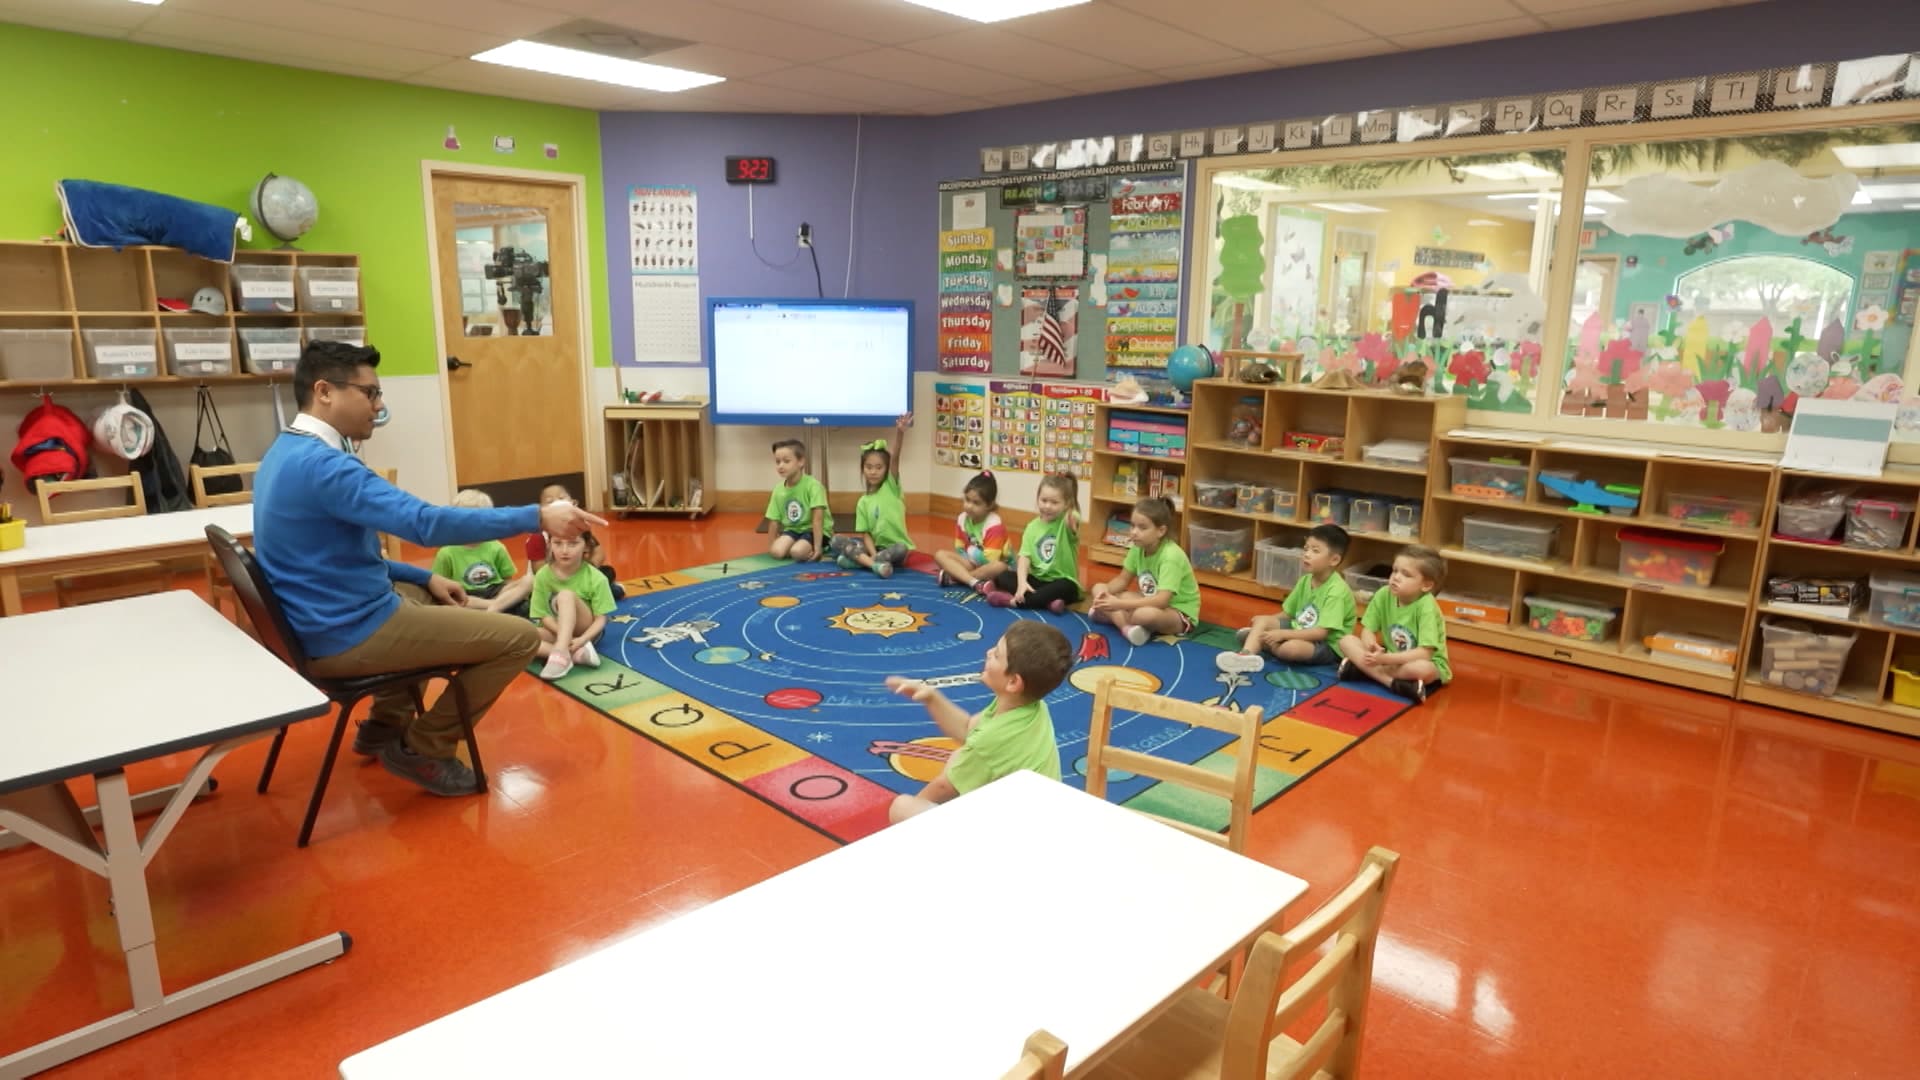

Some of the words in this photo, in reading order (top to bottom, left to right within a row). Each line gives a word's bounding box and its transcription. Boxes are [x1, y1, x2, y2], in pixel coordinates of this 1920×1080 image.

[1152, 139, 1168, 156] Gg
[1184, 136, 1200, 150] Hh
[1289, 127, 1305, 140] Kk
[1363, 119, 1390, 133] Mm
[1503, 105, 1524, 128] Pp
[1550, 99, 1575, 122] Qq
[1604, 95, 1628, 112] Rr
[1664, 89, 1684, 106] Ss
[1004, 186, 1041, 200] REACH
[1122, 196, 1170, 212] February
[947, 233, 987, 246] Sunday
[945, 254, 988, 268] Monday
[943, 274, 989, 288] Tuesday
[941, 294, 991, 310] Wednesday
[942, 315, 991, 332] Thursday
[947, 335, 982, 350] Friday
[942, 355, 990, 371] Saturday
[584, 673, 641, 697] R
[649, 703, 704, 728] Q
[708, 740, 773, 761] P
[789, 775, 848, 801] O
